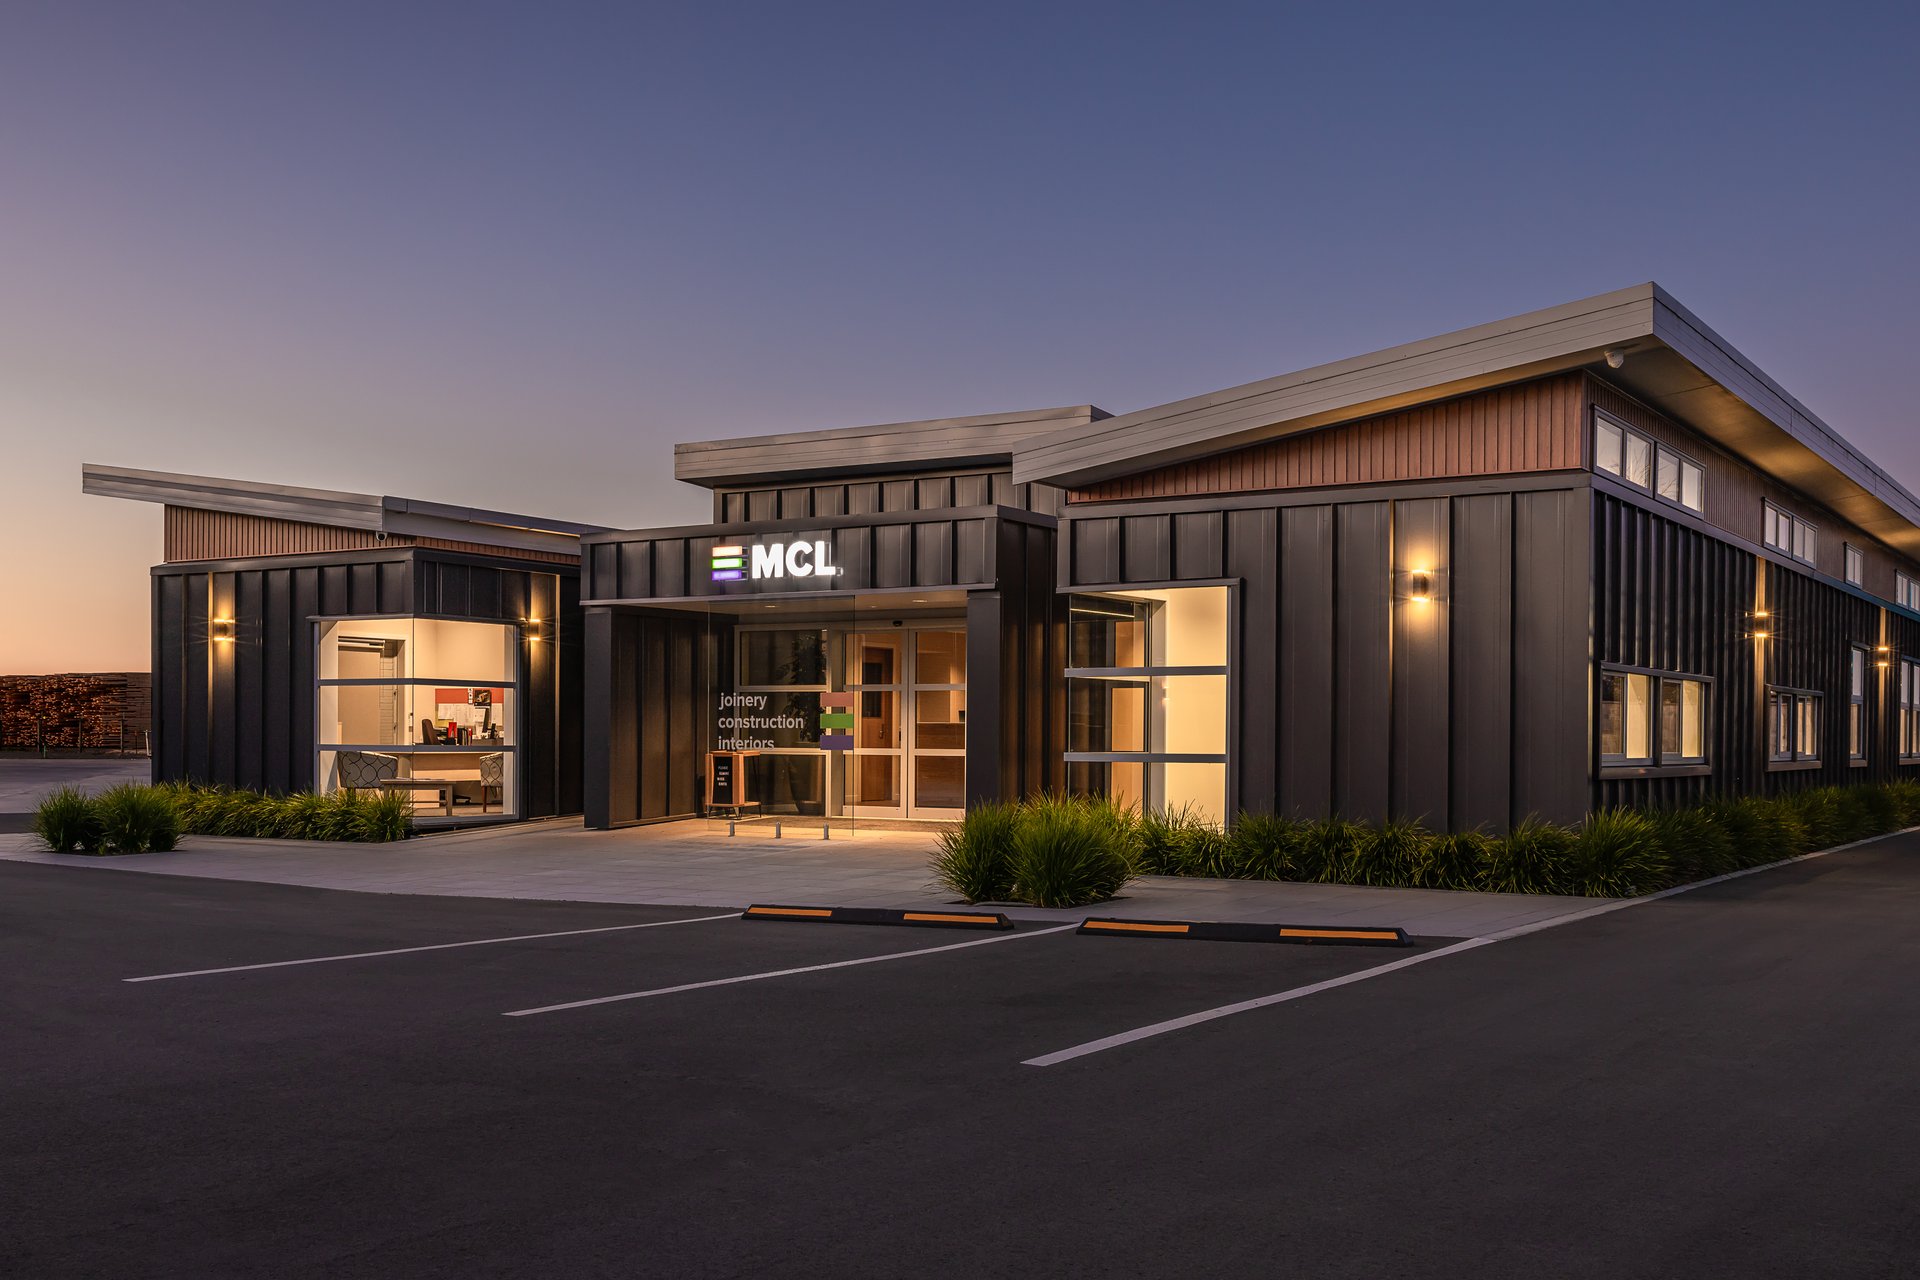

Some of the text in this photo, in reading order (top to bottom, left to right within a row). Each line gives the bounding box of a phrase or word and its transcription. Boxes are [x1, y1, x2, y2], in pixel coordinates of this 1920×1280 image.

[752, 541, 836, 578] MCL
[718, 692, 767, 710] joinery
[718, 714, 804, 729] construction
[718, 735, 775, 750] interiors
